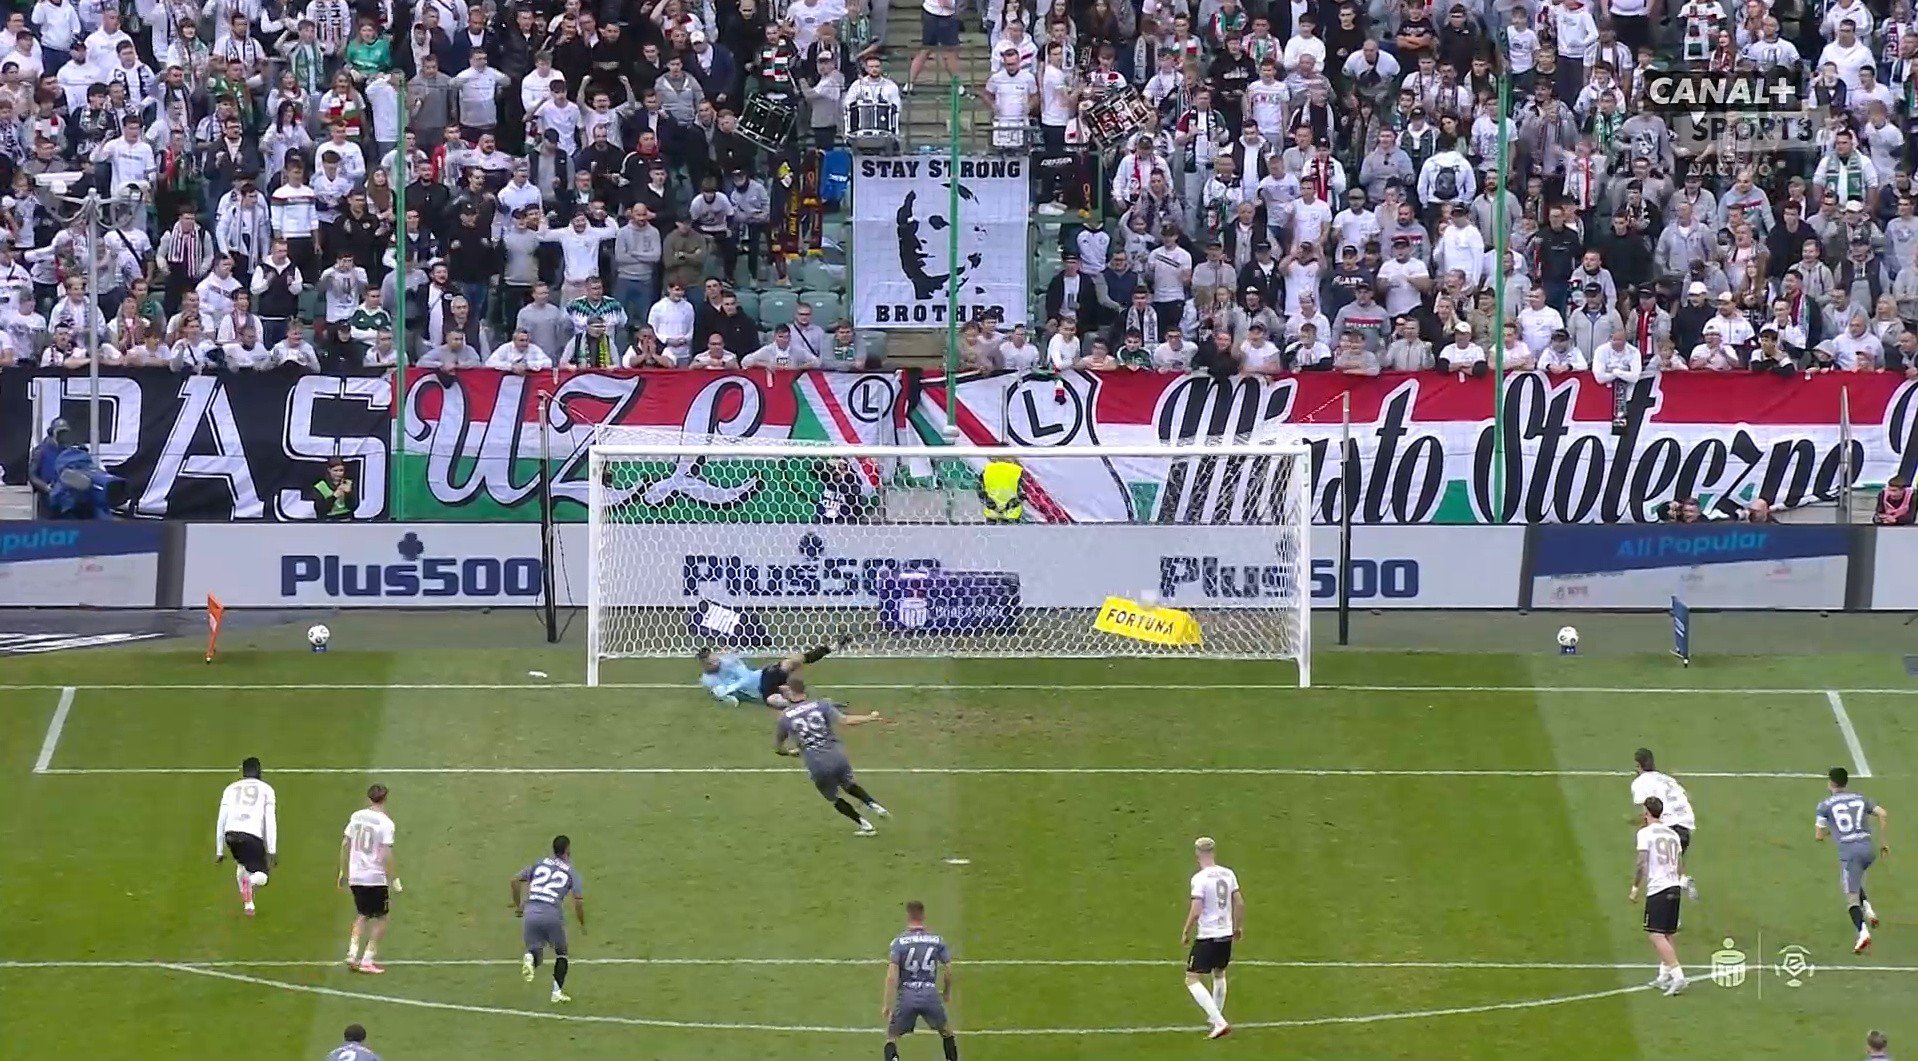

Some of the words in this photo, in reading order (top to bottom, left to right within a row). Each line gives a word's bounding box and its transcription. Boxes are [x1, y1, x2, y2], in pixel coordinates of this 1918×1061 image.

[862, 160, 919, 178] STAY
[929, 160, 1021, 178] STRONG
[876, 305, 1004, 323] BROTHER
[0, 528, 79, 554] pular
[1658, 529, 1768, 557] Popular
[281, 555, 542, 597] Plus500
[1106, 608, 1174, 635] FORTUNA
[233, 785, 259, 806] 19
[1832, 800, 1865, 832] 67
[355, 823, 376, 855] 10
[1655, 837, 1679, 866] 90
[530, 866, 568, 897] 22
[1216, 879, 1229, 909] 9
[905, 947, 935, 978] 44
